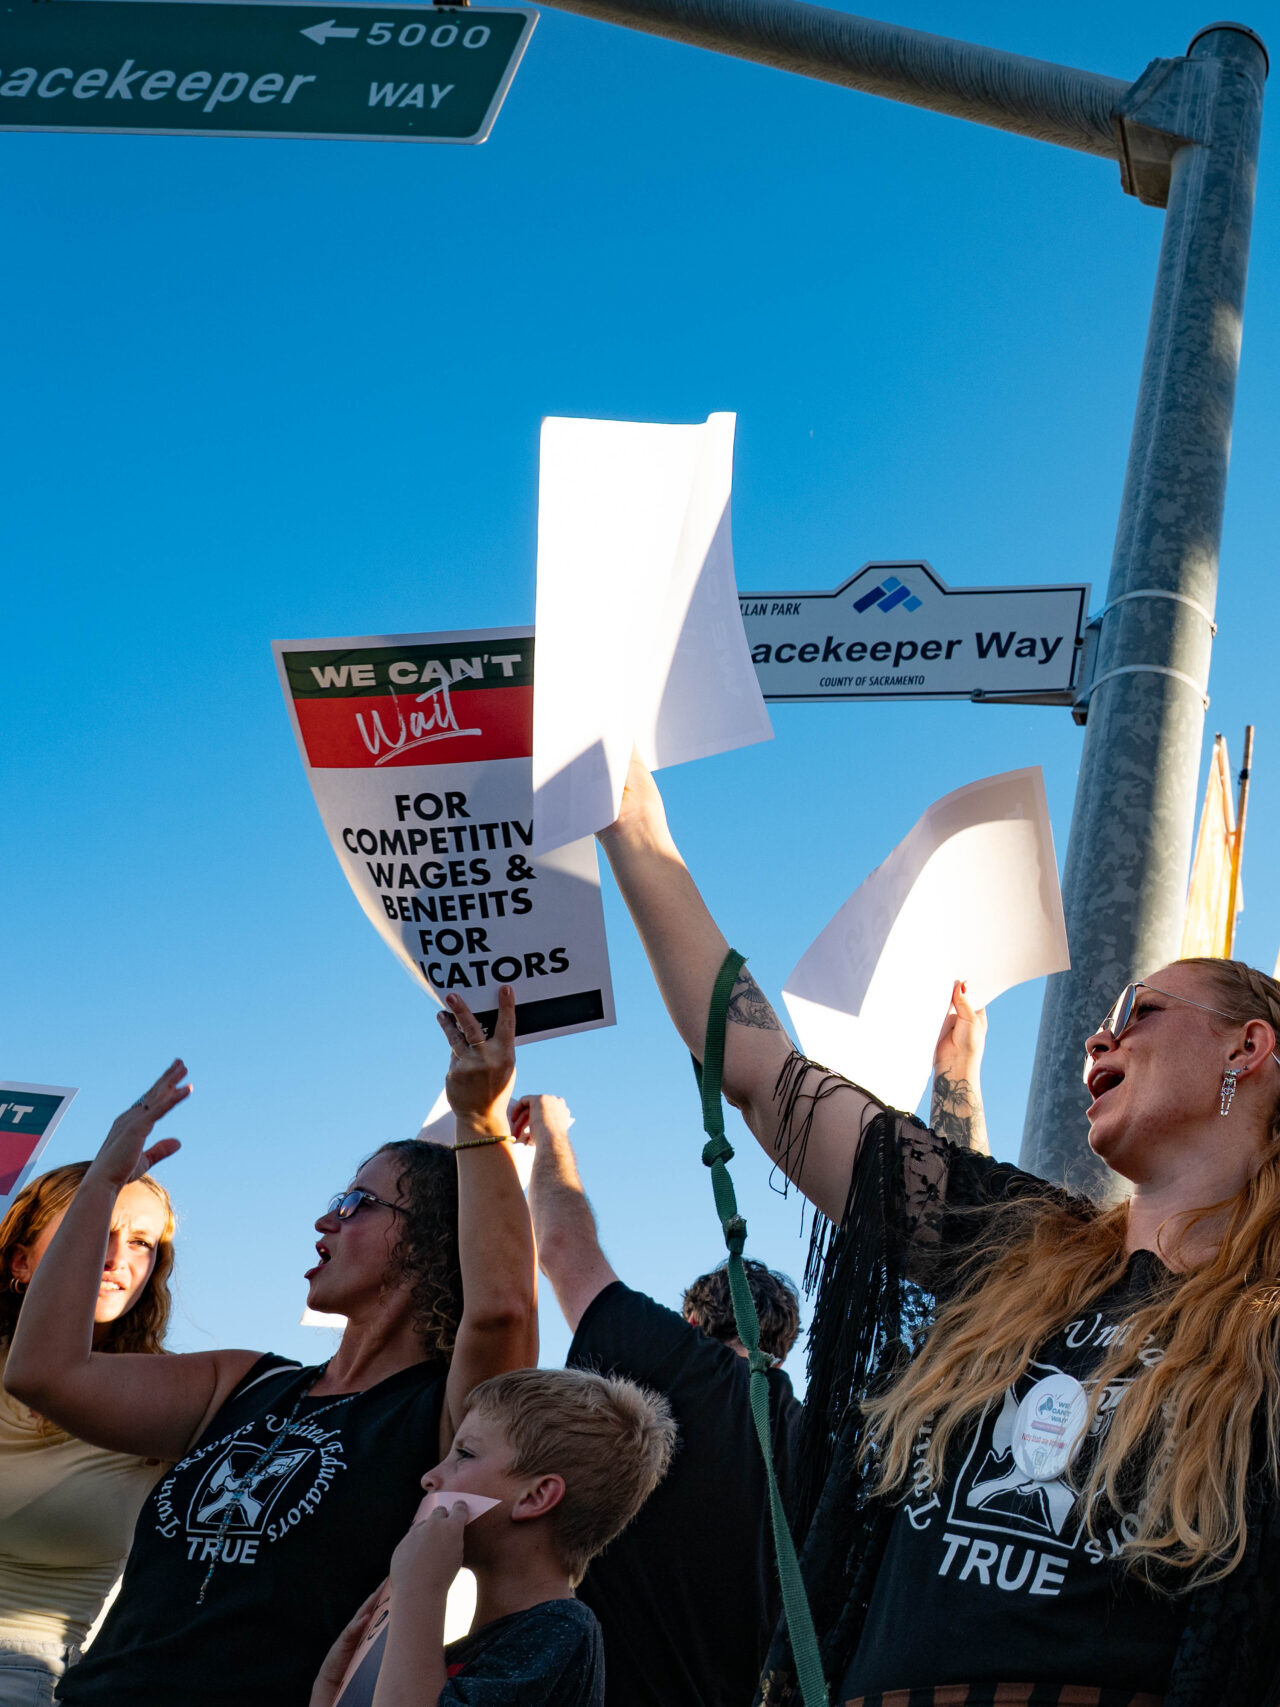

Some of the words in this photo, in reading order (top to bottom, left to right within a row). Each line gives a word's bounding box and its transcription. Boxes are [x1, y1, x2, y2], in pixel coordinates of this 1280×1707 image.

[366, 22, 492, 48] 5000
[0, 60, 315, 112] acekeeper
[367, 82, 455, 109] WAY
[740, 603, 768, 616] LLAN
[771, 602, 802, 616] PARK
[751, 635, 962, 667] acekeeper
[975, 631, 1063, 664] Way
[311, 664, 376, 689] WE
[388, 654, 522, 685] CAN'T
[819, 677, 853, 688] COUNTY
[855, 677, 867, 687] OF
[868, 675, 925, 687] SACRAMENTO
[355, 670, 476, 756] Wait
[395, 791, 471, 821] FOR
[342, 819, 534, 856] COMPETITIV
[366, 858, 491, 889] WAGES
[506, 854, 537, 882] &
[381, 887, 533, 923] BENEFITS
[419, 927, 492, 957] FOR
[417, 947, 570, 989] CATORS
[154, 1476, 181, 1538] Twin
[174, 1421, 256, 1472] Rivers
[267, 1441, 348, 1543] Educators
[186, 1536, 260, 1564] TRUE
[937, 1532, 1070, 1597] TRUE
